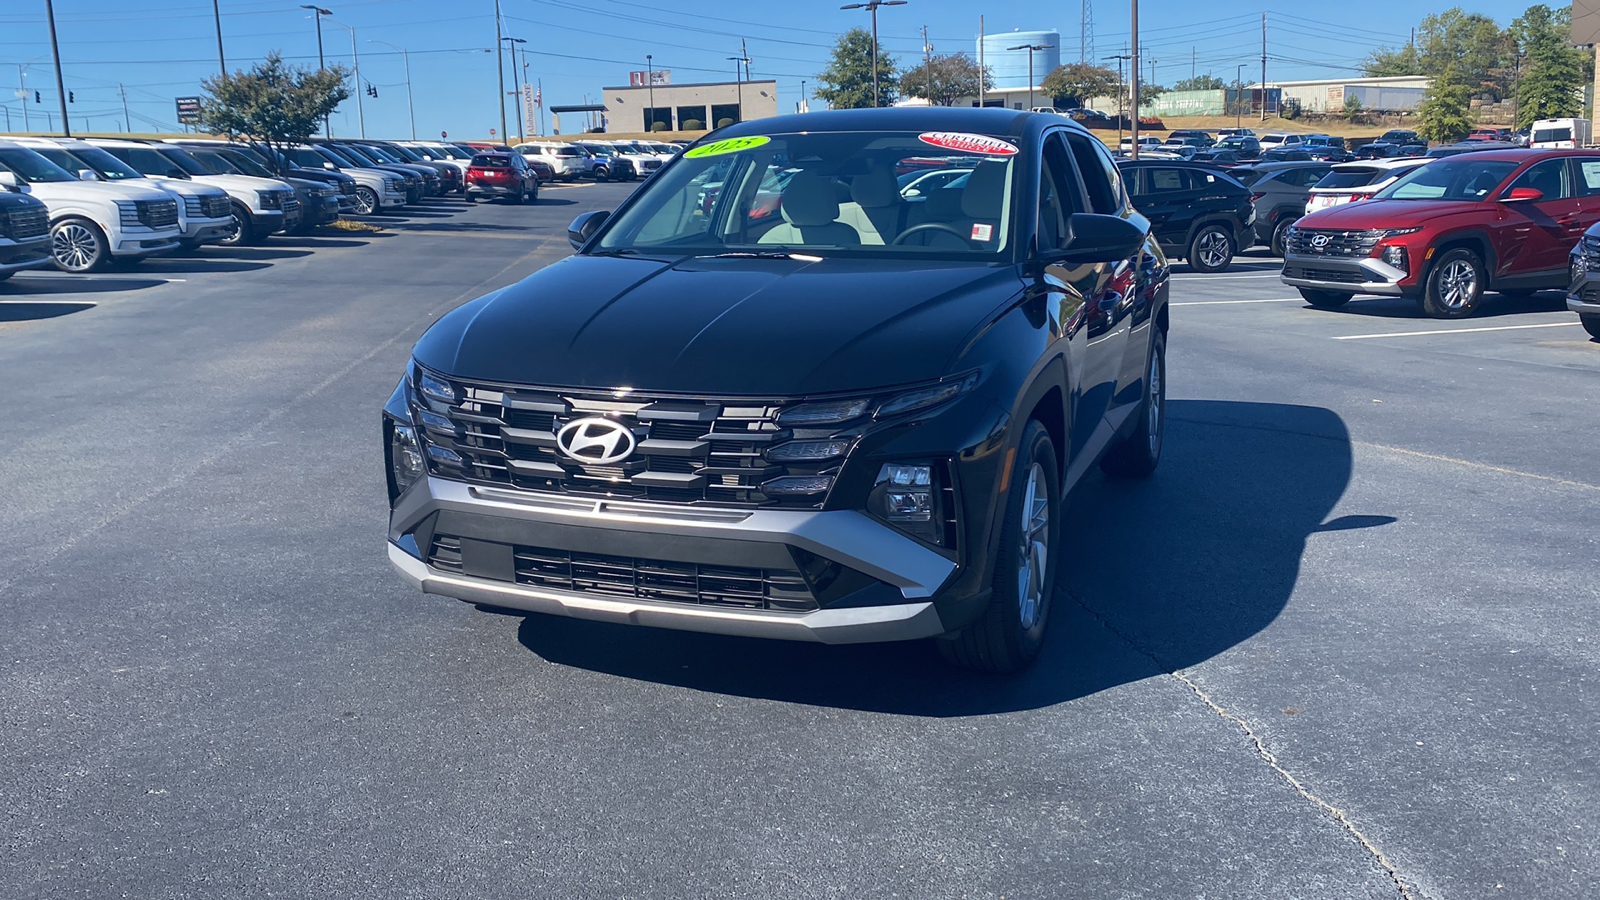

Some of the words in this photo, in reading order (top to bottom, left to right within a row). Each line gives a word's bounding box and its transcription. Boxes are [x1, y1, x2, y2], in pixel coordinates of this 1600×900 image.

[1176, 99, 1203, 109] SHIPPING
[694, 137, 759, 156] 2025
[932, 132, 1009, 149] CERTIFIED
